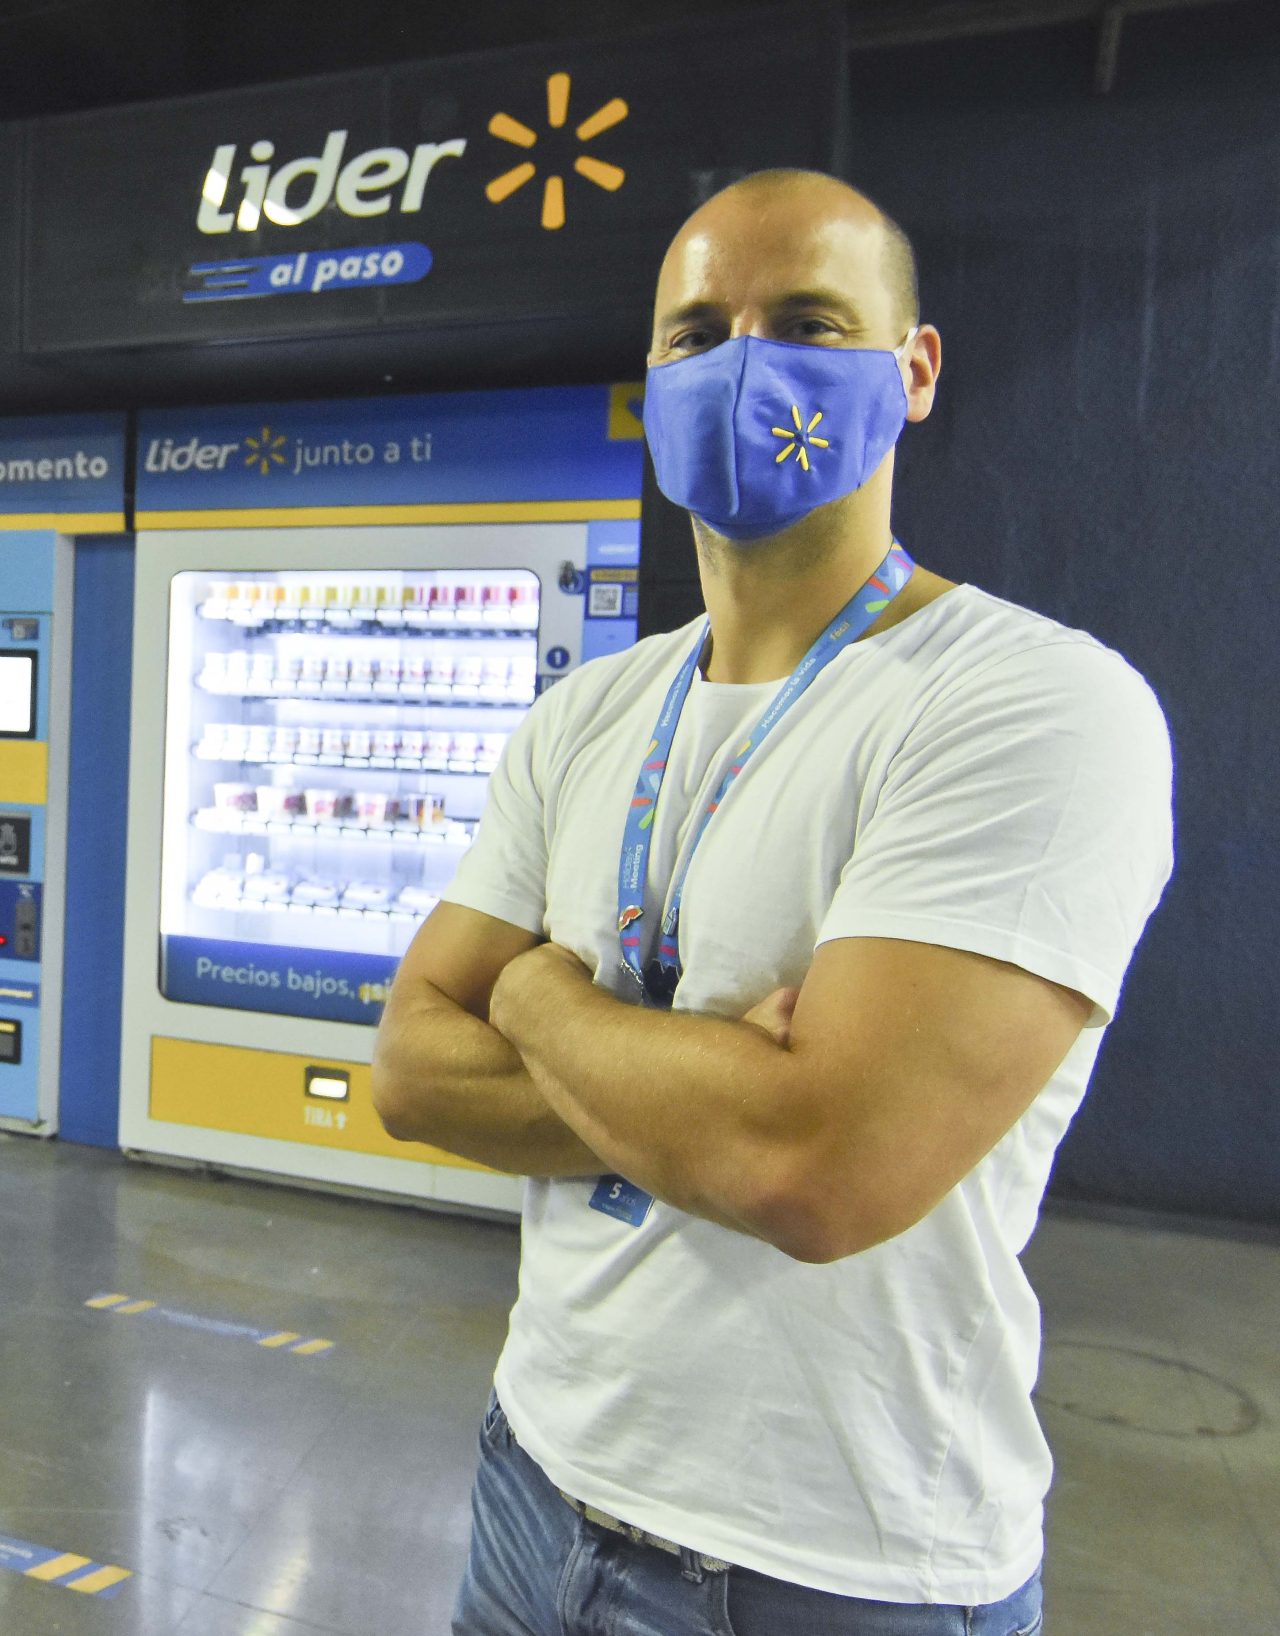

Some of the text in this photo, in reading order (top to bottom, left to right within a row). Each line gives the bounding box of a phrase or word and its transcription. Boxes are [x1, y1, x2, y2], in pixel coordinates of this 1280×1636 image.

[197, 129, 468, 234] Lider
[269, 250, 404, 293] al paso
[144, 433, 433, 475] Lider junto a ti
[554, 651, 562, 666] 1
[630, 843, 644, 889] Meeting
[196, 956, 281, 988] Precios
[287, 966, 355, 1000] bajos,
[304, 1104, 333, 1128] TIRA
[608, 1182, 623, 1199] 5
